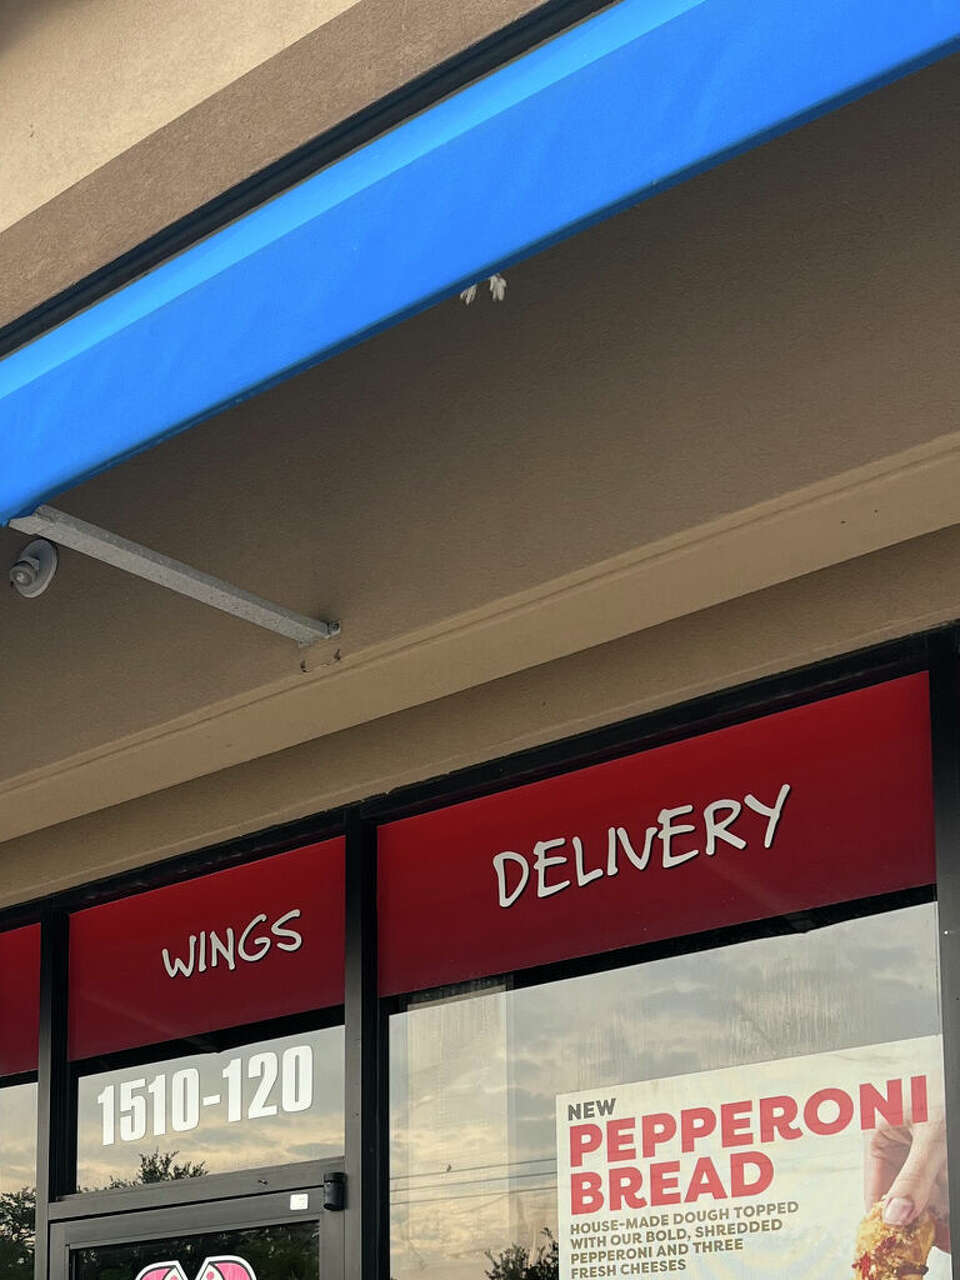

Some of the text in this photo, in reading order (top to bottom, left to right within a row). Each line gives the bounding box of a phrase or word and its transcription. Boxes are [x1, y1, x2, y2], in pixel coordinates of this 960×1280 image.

[493, 783, 791, 910] DELIVERY
[161, 908, 304, 979] WINGS
[97, 1044, 315, 1147] 1510-120
[567, 1098, 616, 1121] NEW
[569, 1075, 929, 1168] PEPPERONI
[570, 1151, 775, 1215] BREAD
[570, 1201, 799, 1235] HOUSE-MADE DOUGH TOPPED
[570, 1219, 783, 1250] WITH OUR BOLD, SHREDDED
[570, 1239, 744, 1265] PEPPERONI AND THREE
[571, 1259, 687, 1279] FRESH CHEESES
